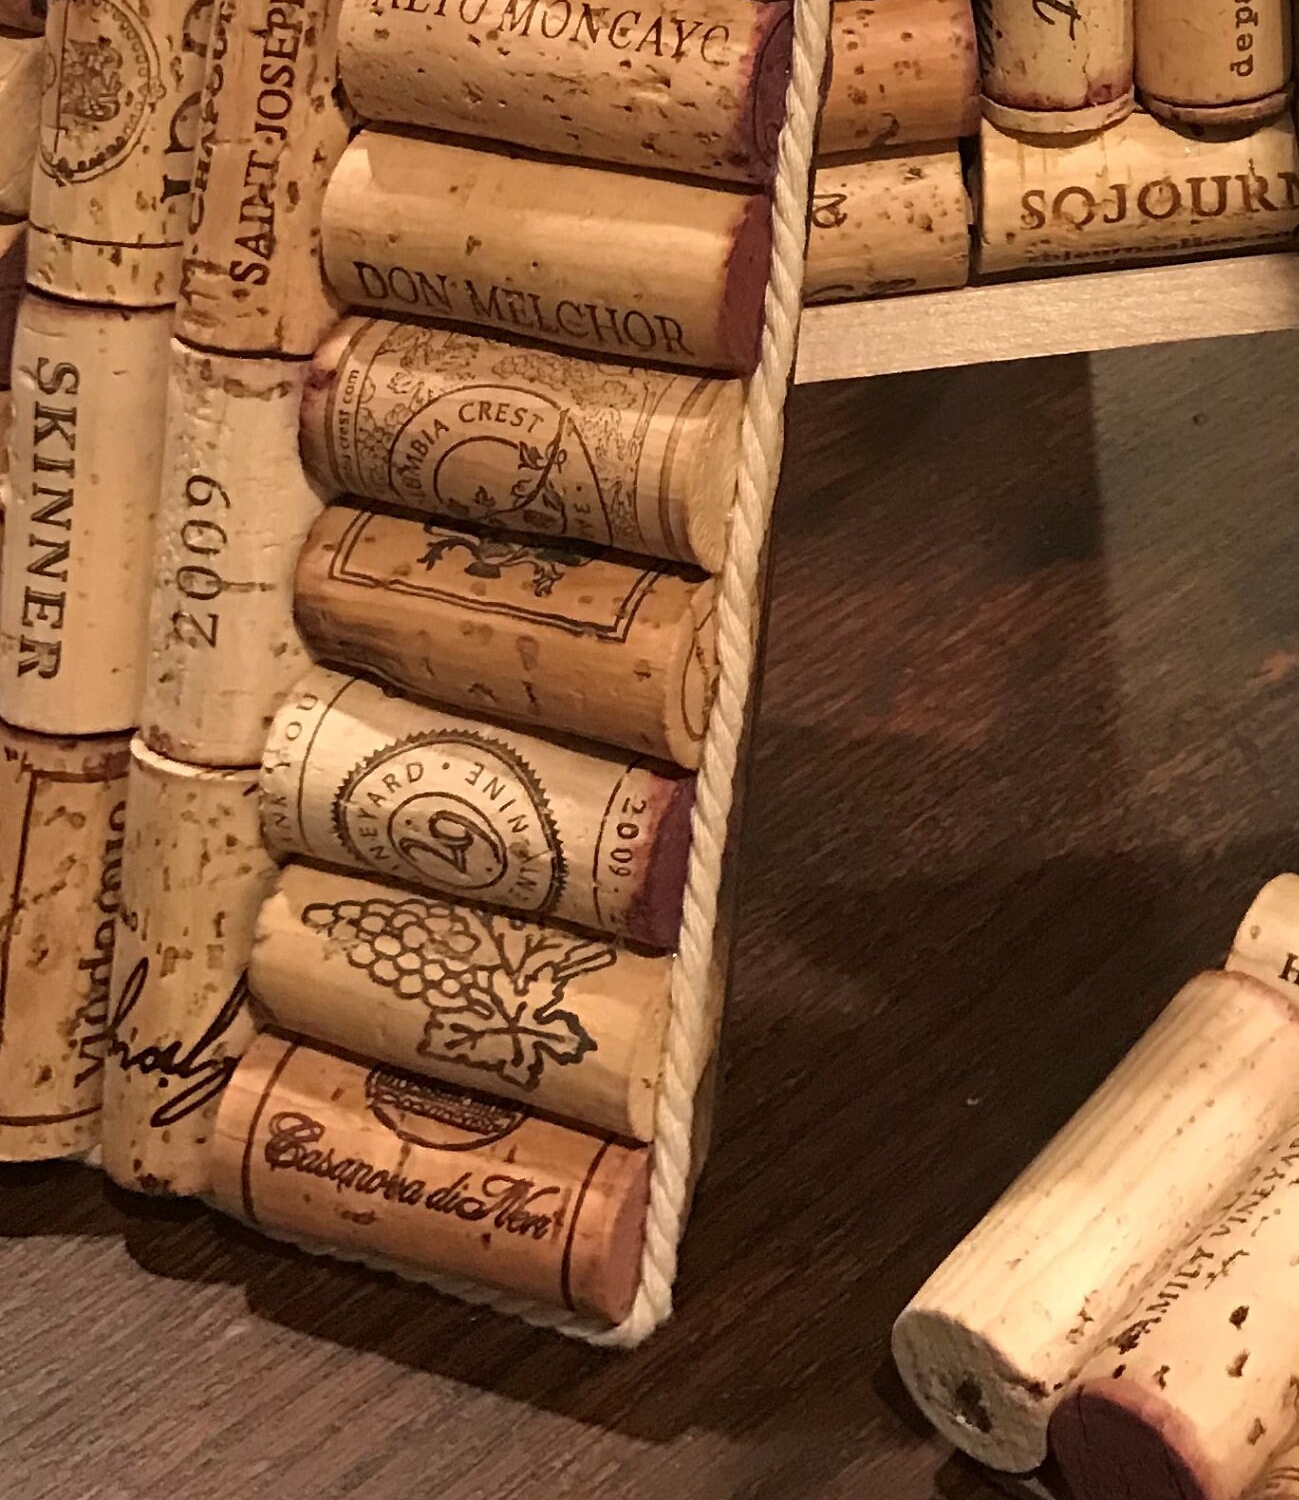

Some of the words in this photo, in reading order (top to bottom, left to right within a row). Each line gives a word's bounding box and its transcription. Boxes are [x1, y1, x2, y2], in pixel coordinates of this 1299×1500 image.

[353, 261, 456, 311] DON
[464, 280, 695, 356] MELCHOR
[458, 400, 546, 434] CREST
[17, 357, 80, 680] SKINNER
[172, 474, 231, 648] 2009
[355, 760, 425, 866] NEYARD
[1116, 1248, 1214, 1354] AMILY
